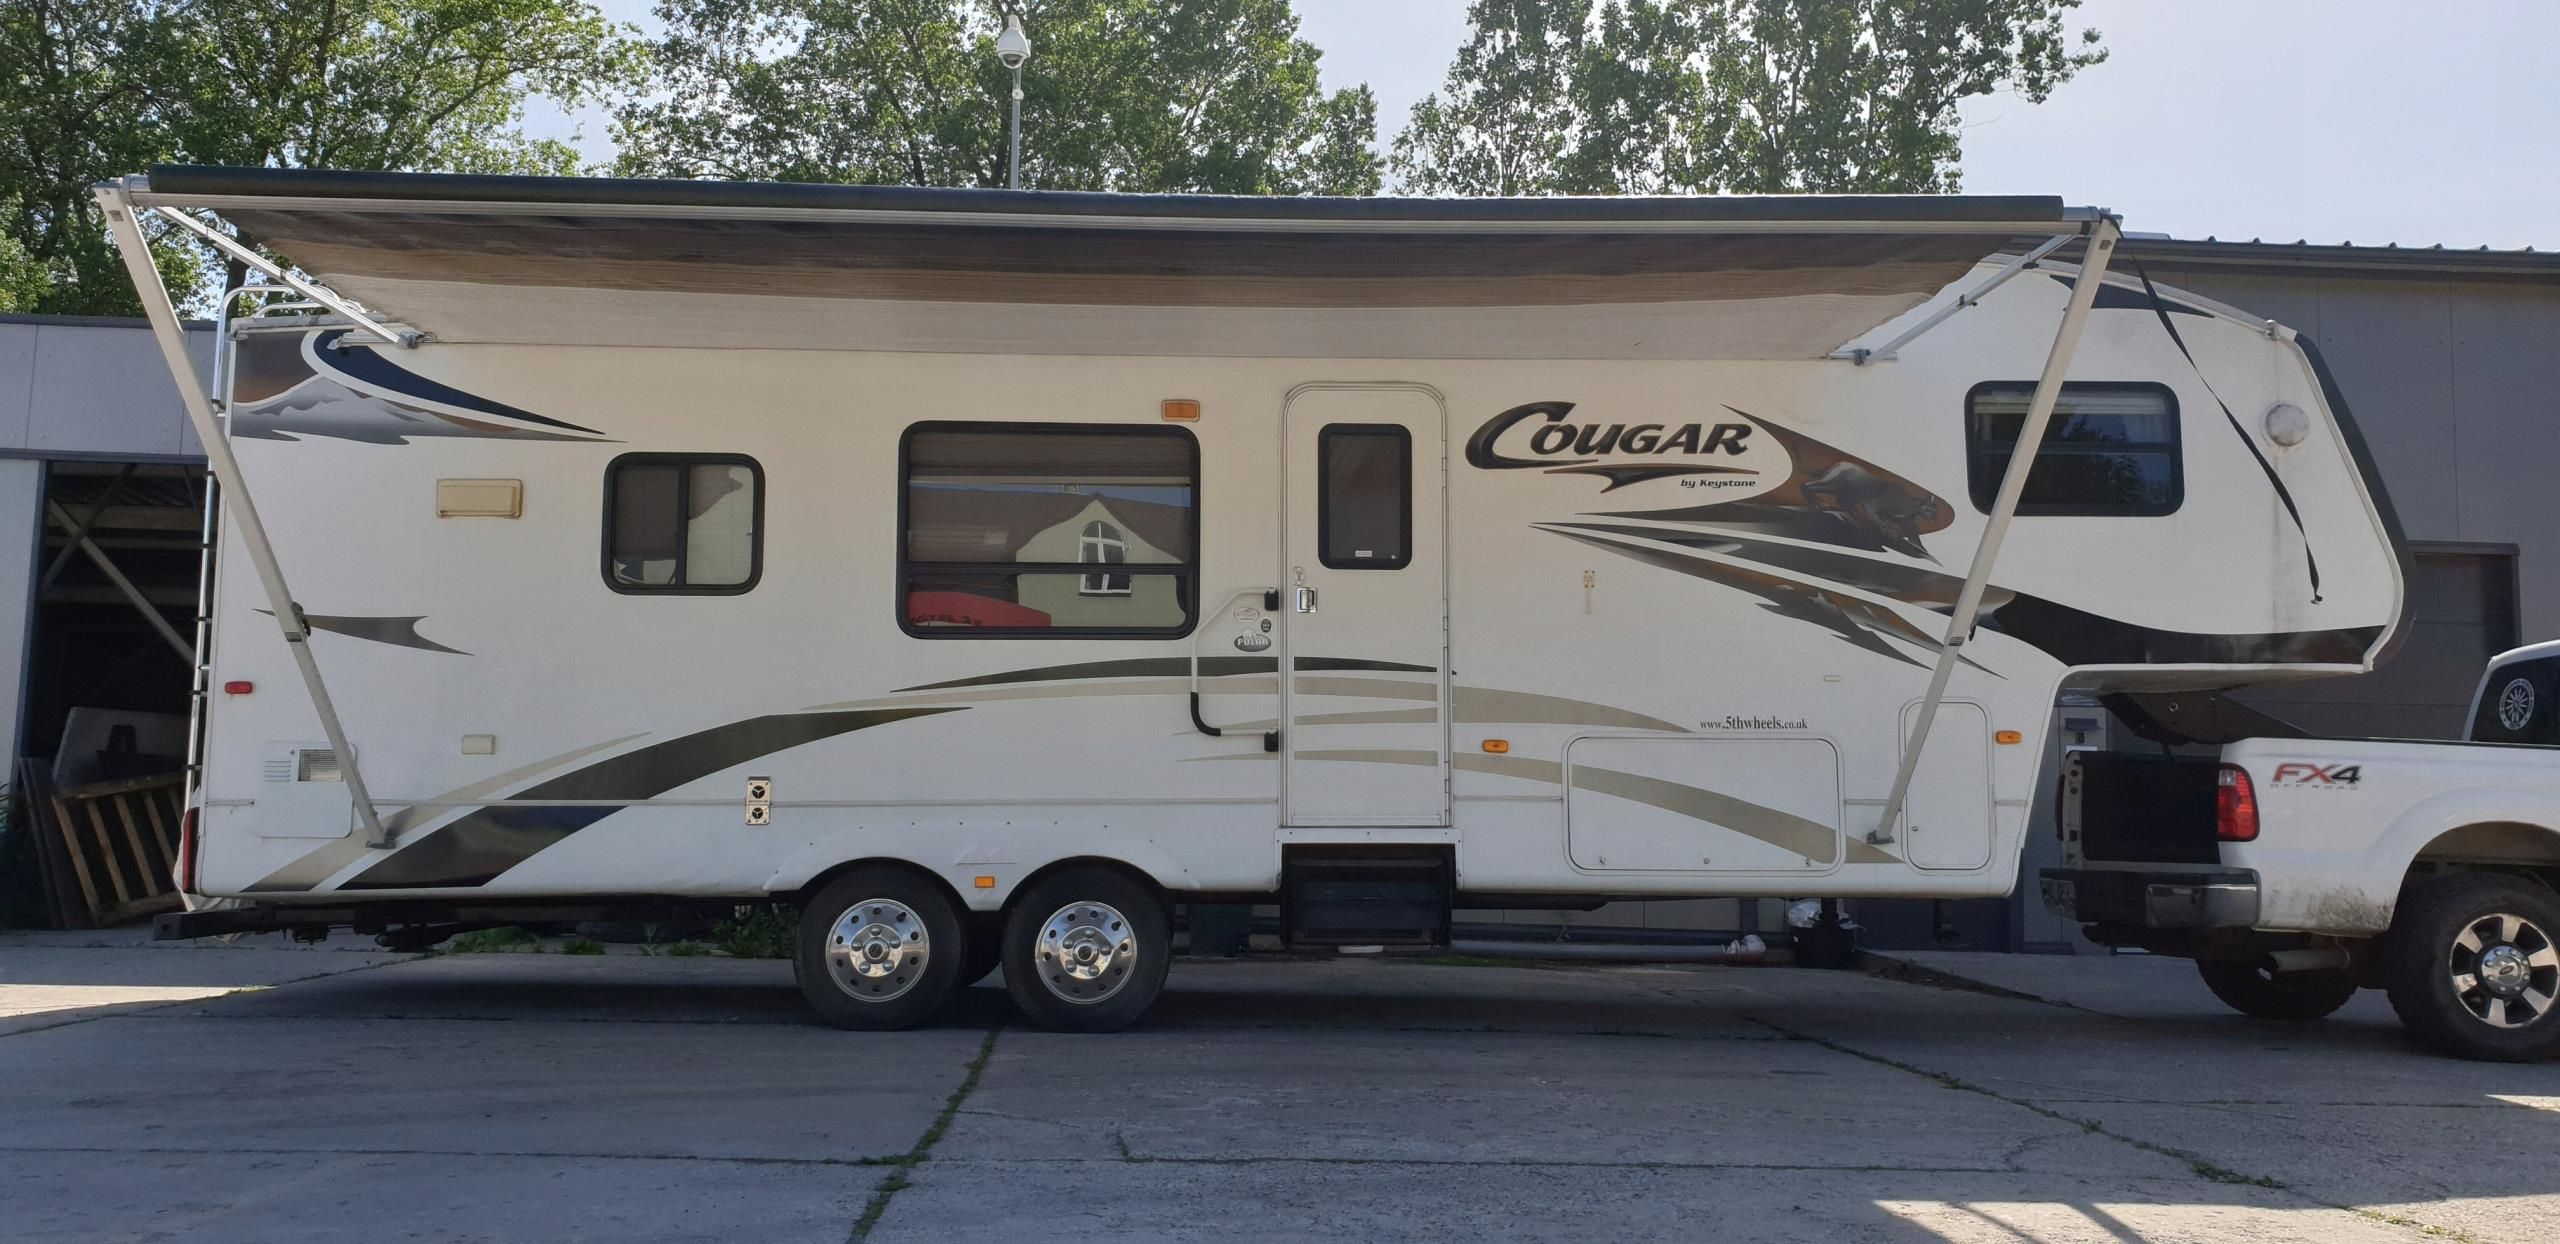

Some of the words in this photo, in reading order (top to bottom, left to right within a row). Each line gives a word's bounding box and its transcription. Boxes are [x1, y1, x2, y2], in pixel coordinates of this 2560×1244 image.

[1680, 480, 1696, 488] by
[1700, 480, 1756, 488] Keystone
[1700, 716, 1808, 730] www.5thwheels.co.uk
[2272, 763, 2361, 784] FX4
